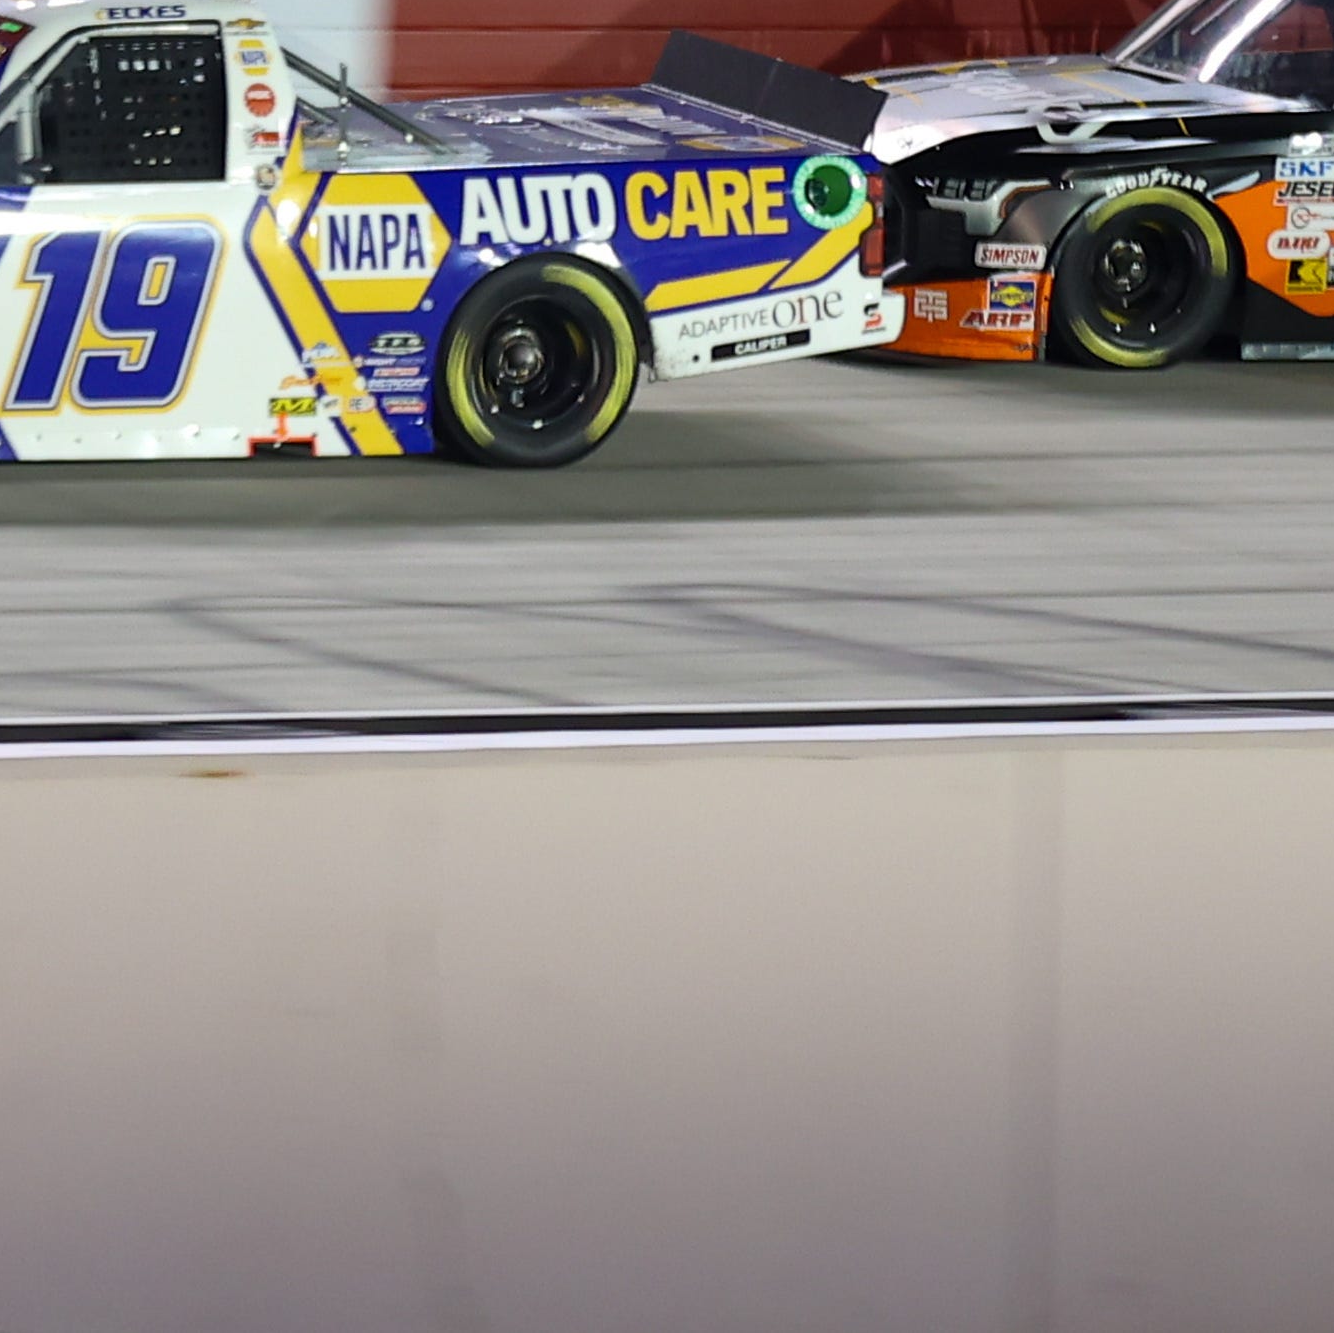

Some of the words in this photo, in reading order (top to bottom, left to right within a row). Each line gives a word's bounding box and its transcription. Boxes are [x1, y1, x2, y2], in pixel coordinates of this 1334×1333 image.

[107, 5, 186, 20] ECKES
[1105, 166, 1208, 199] GOODYEAR
[459, 172, 617, 246] AUTO
[624, 166, 791, 241] CARE
[327, 212, 427, 272] NAPA
[980, 246, 1040, 264] SIMPSON
[679, 308, 769, 340] ADAPTIVE
[961, 310, 1033, 328] ARP
[734, 335, 788, 355] CALIPER
